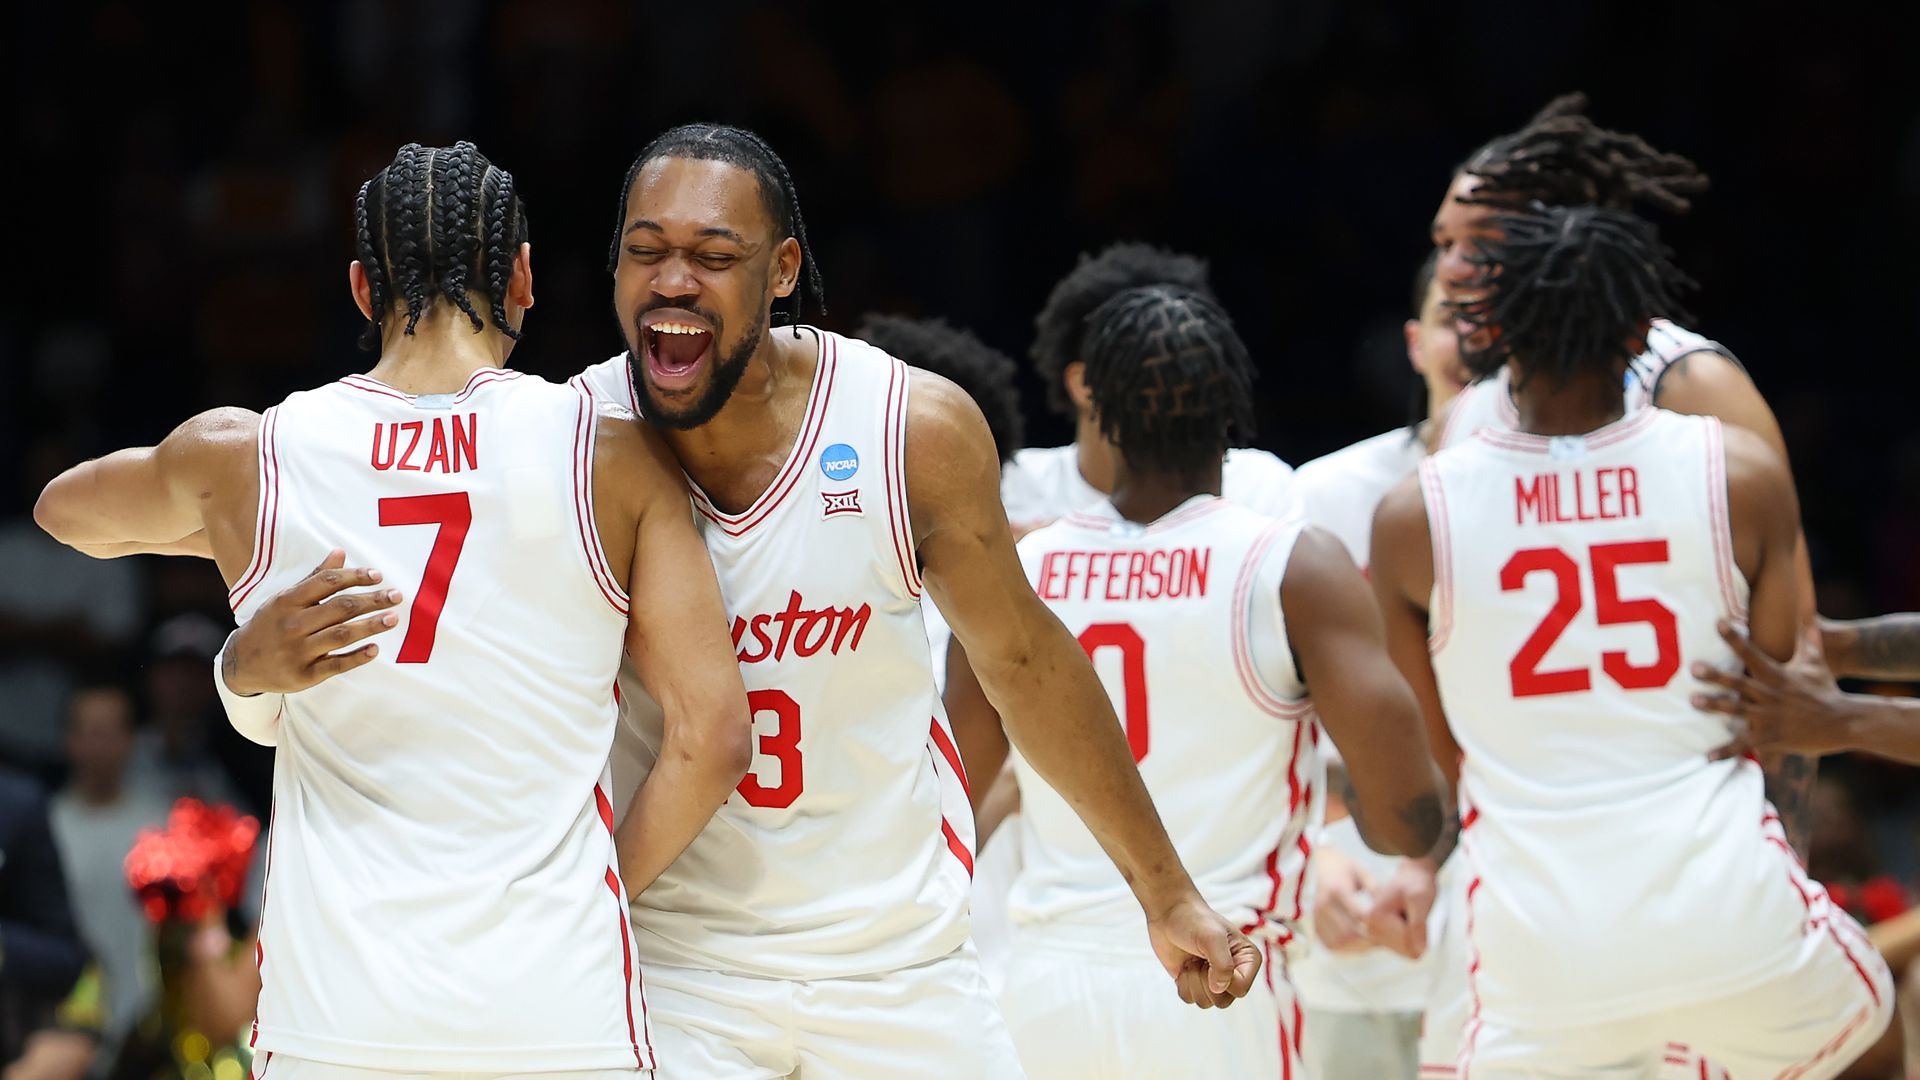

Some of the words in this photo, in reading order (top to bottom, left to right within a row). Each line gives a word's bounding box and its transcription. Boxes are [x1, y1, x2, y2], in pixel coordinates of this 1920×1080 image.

[371, 412, 478, 474] UZAN
[826, 459, 857, 472] NCAA
[1515, 466, 1641, 525] MILLER
[378, 491, 472, 664] 7
[1499, 538, 1682, 699] 25
[723, 688, 804, 809] 3
